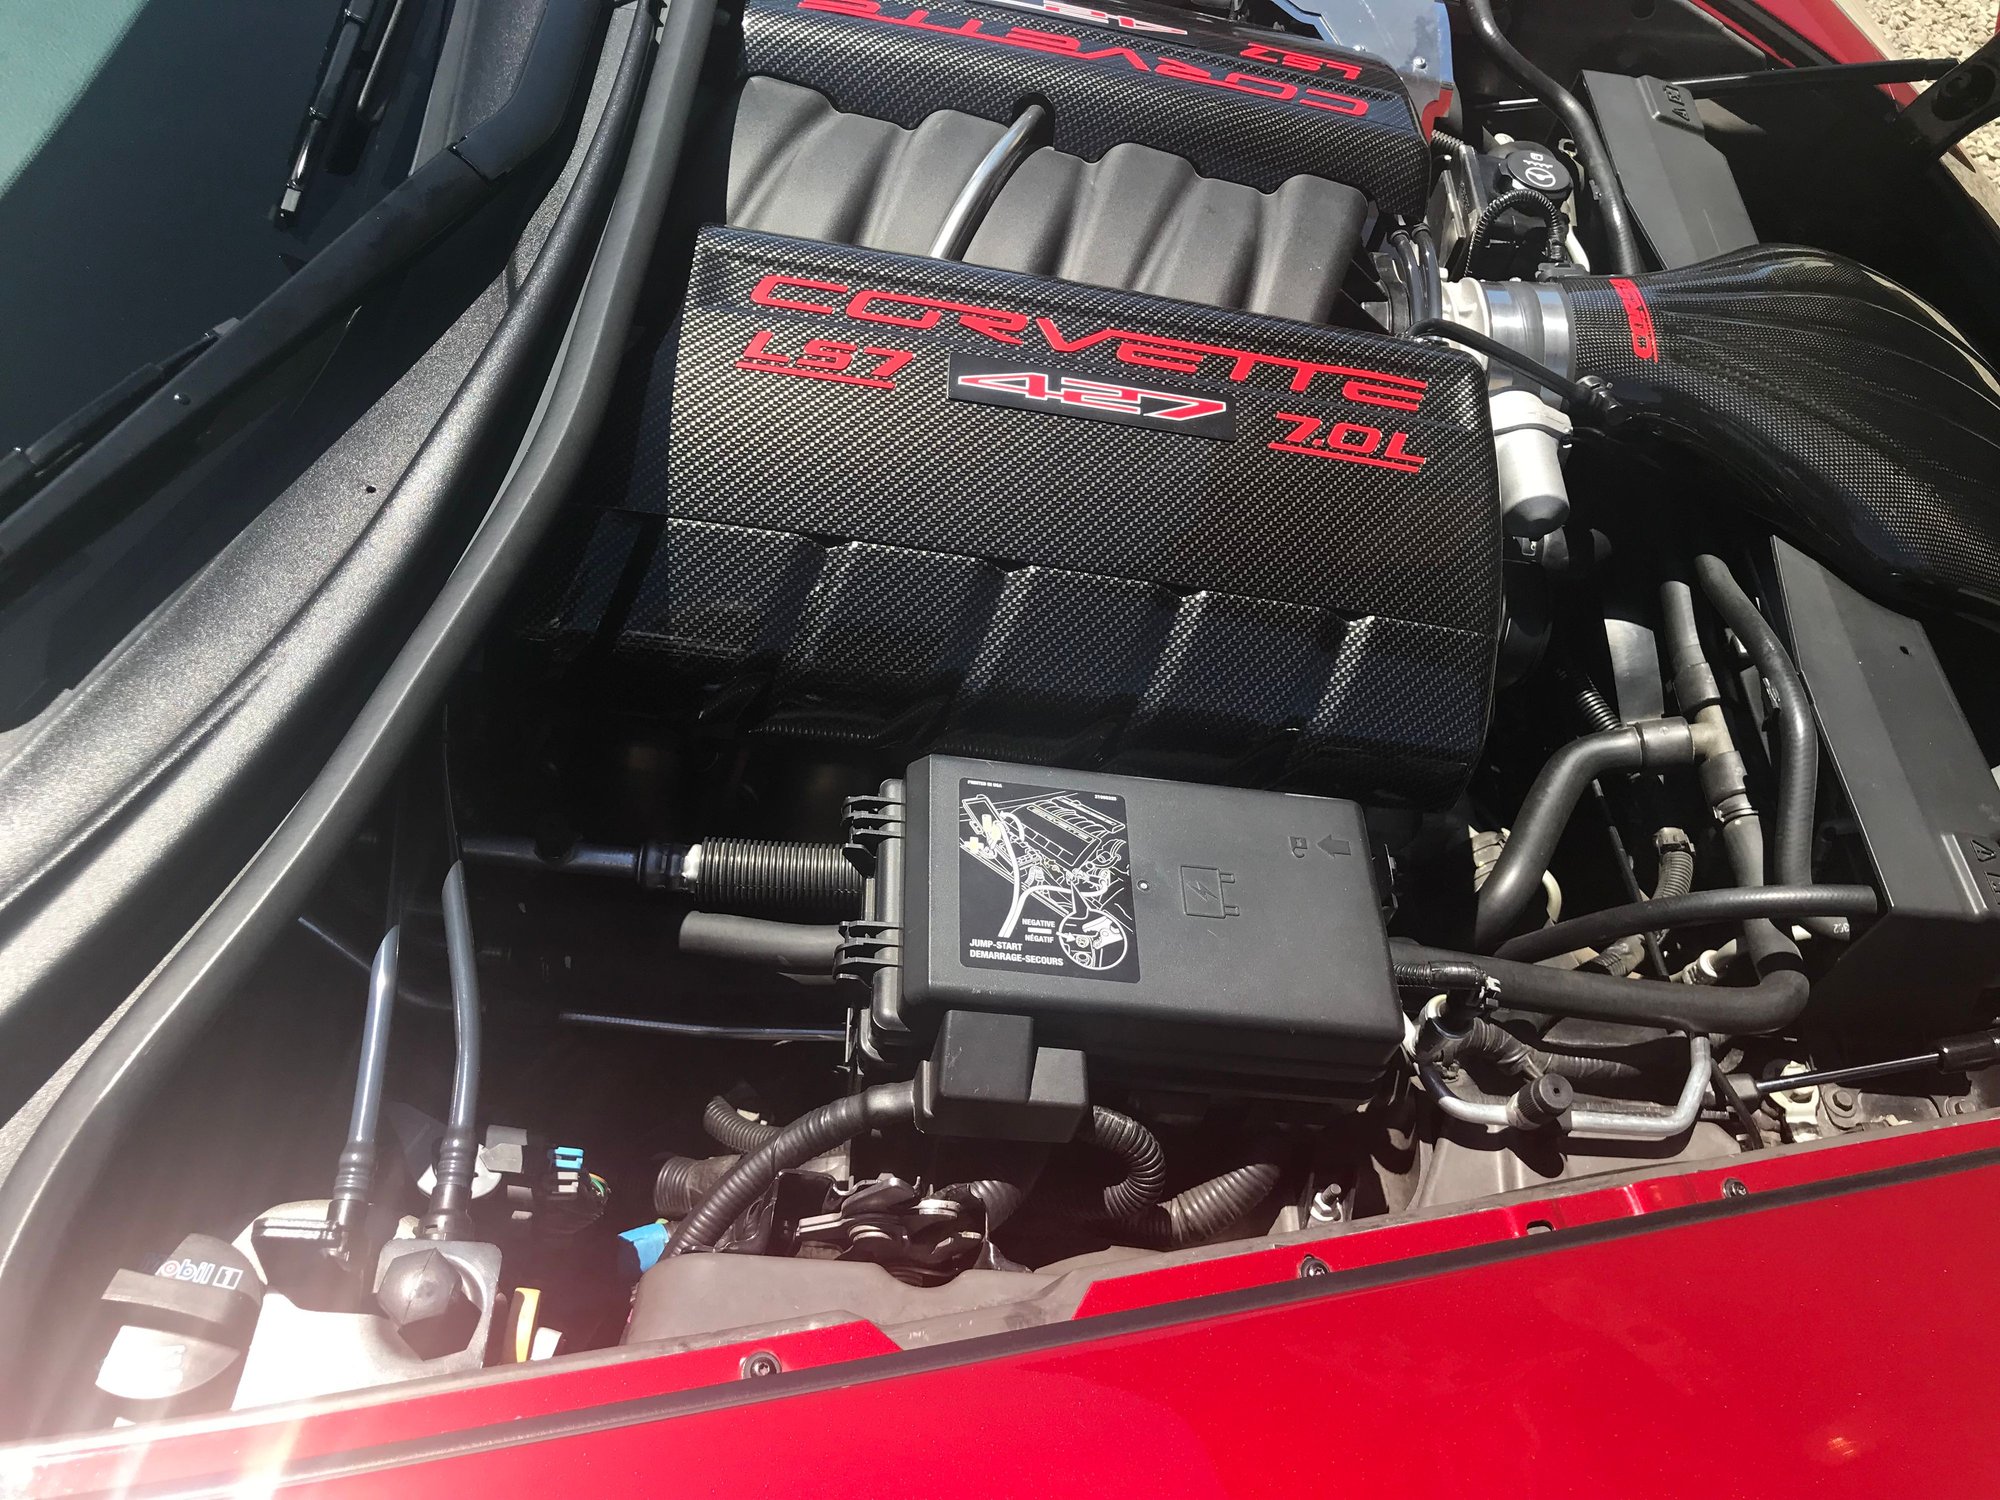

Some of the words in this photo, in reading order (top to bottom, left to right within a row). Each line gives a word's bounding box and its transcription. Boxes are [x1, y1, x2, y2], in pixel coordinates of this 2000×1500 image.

[1240, 43, 1361, 80] LS7
[742, 331, 915, 378] LS7
[750, 275, 1428, 411] CORVETTE
[958, 372, 1226, 421] 427
[1275, 411, 1427, 464] 7.0L
[1022, 918, 1056, 928] NEGATIVE
[1024, 933, 1054, 943] NÉGATIF
[969, 938, 1023, 951] JUMP-START
[969, 949, 1064, 966] DEMARRAGE-SECOURS
